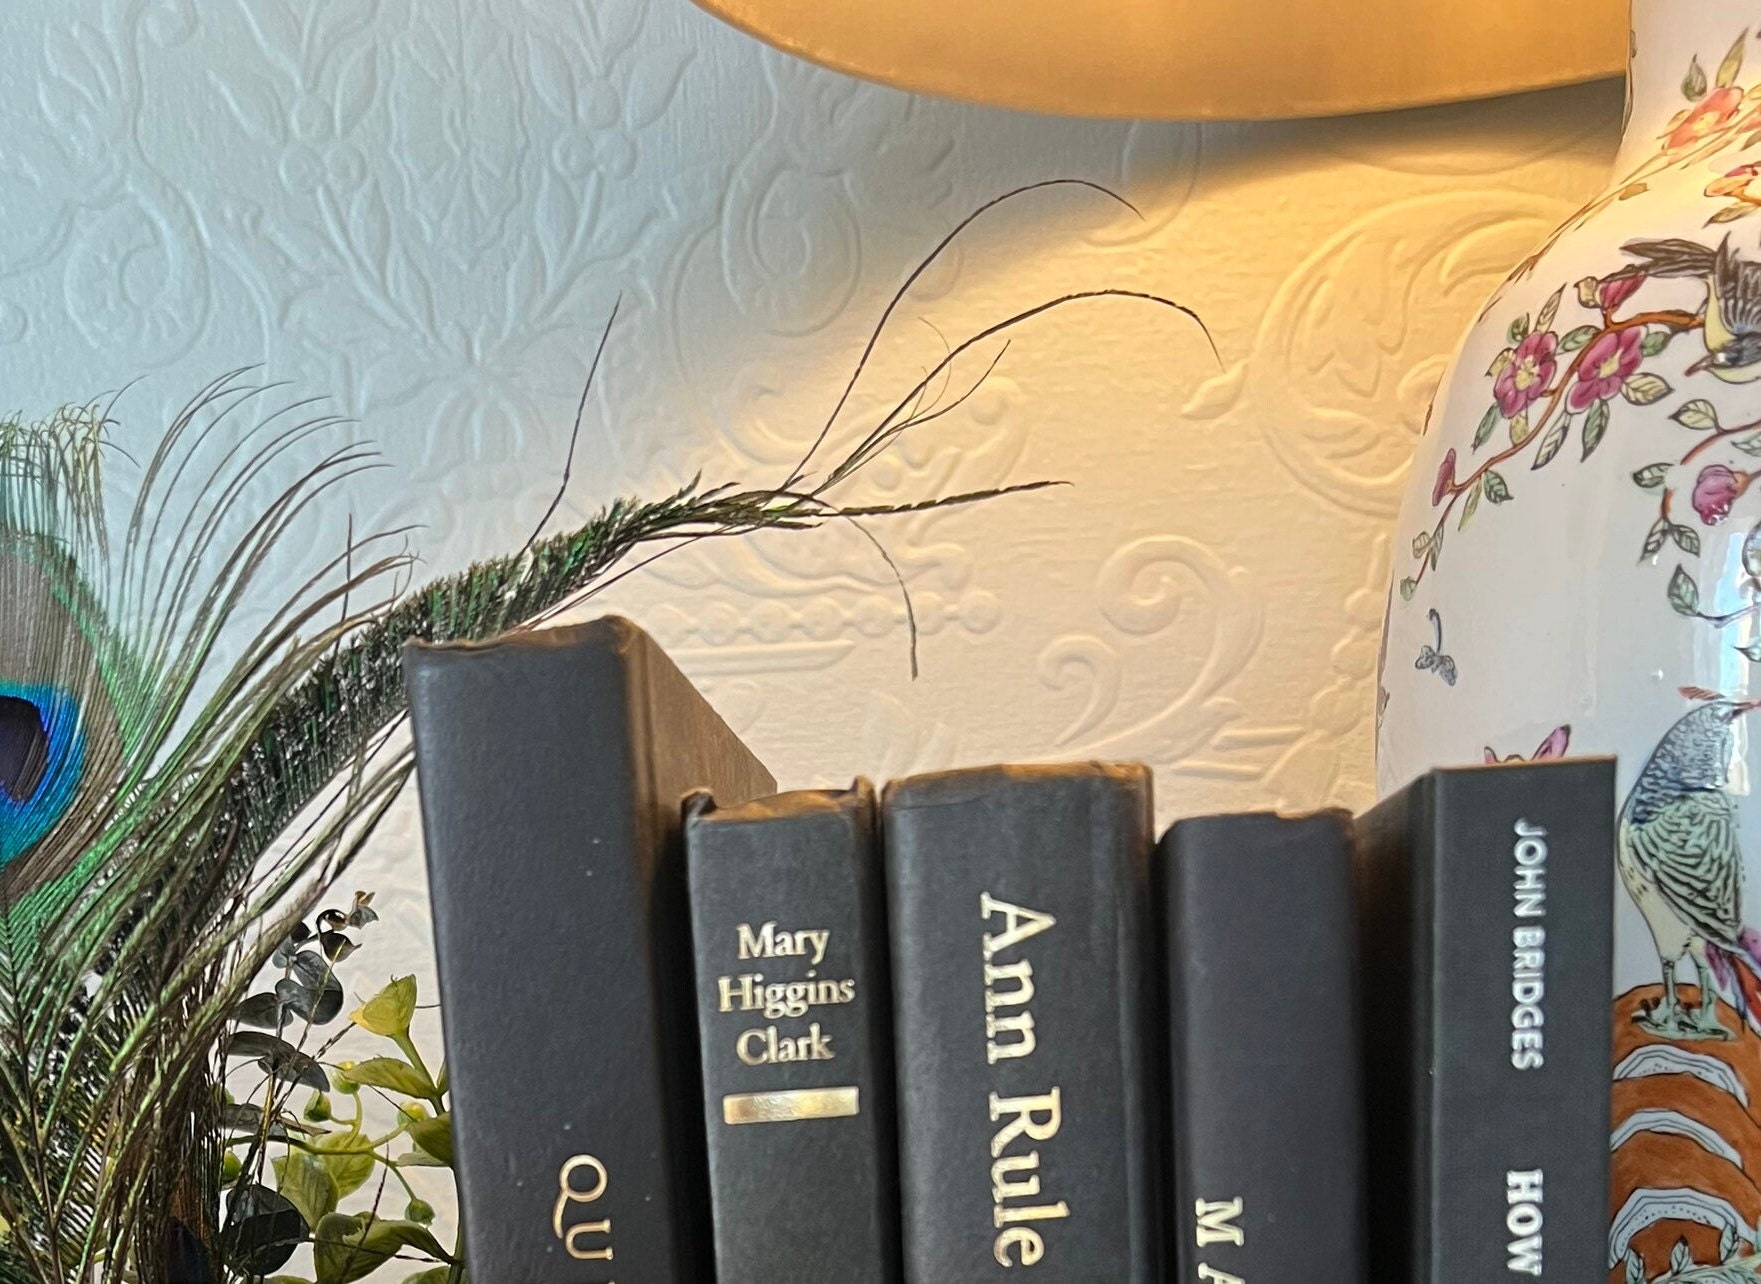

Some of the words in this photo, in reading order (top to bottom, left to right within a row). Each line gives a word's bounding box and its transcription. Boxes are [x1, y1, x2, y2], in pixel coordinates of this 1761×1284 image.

[1513, 818, 1547, 917] JOHN
[737, 922, 829, 965] Mary
[980, 892, 1055, 1065] Ann
[718, 971, 855, 1018] Higgins
[736, 1022, 834, 1064] Clark
[1511, 927, 1545, 1069] BRIDGES
[1506, 1169, 1544, 1276] HOW
